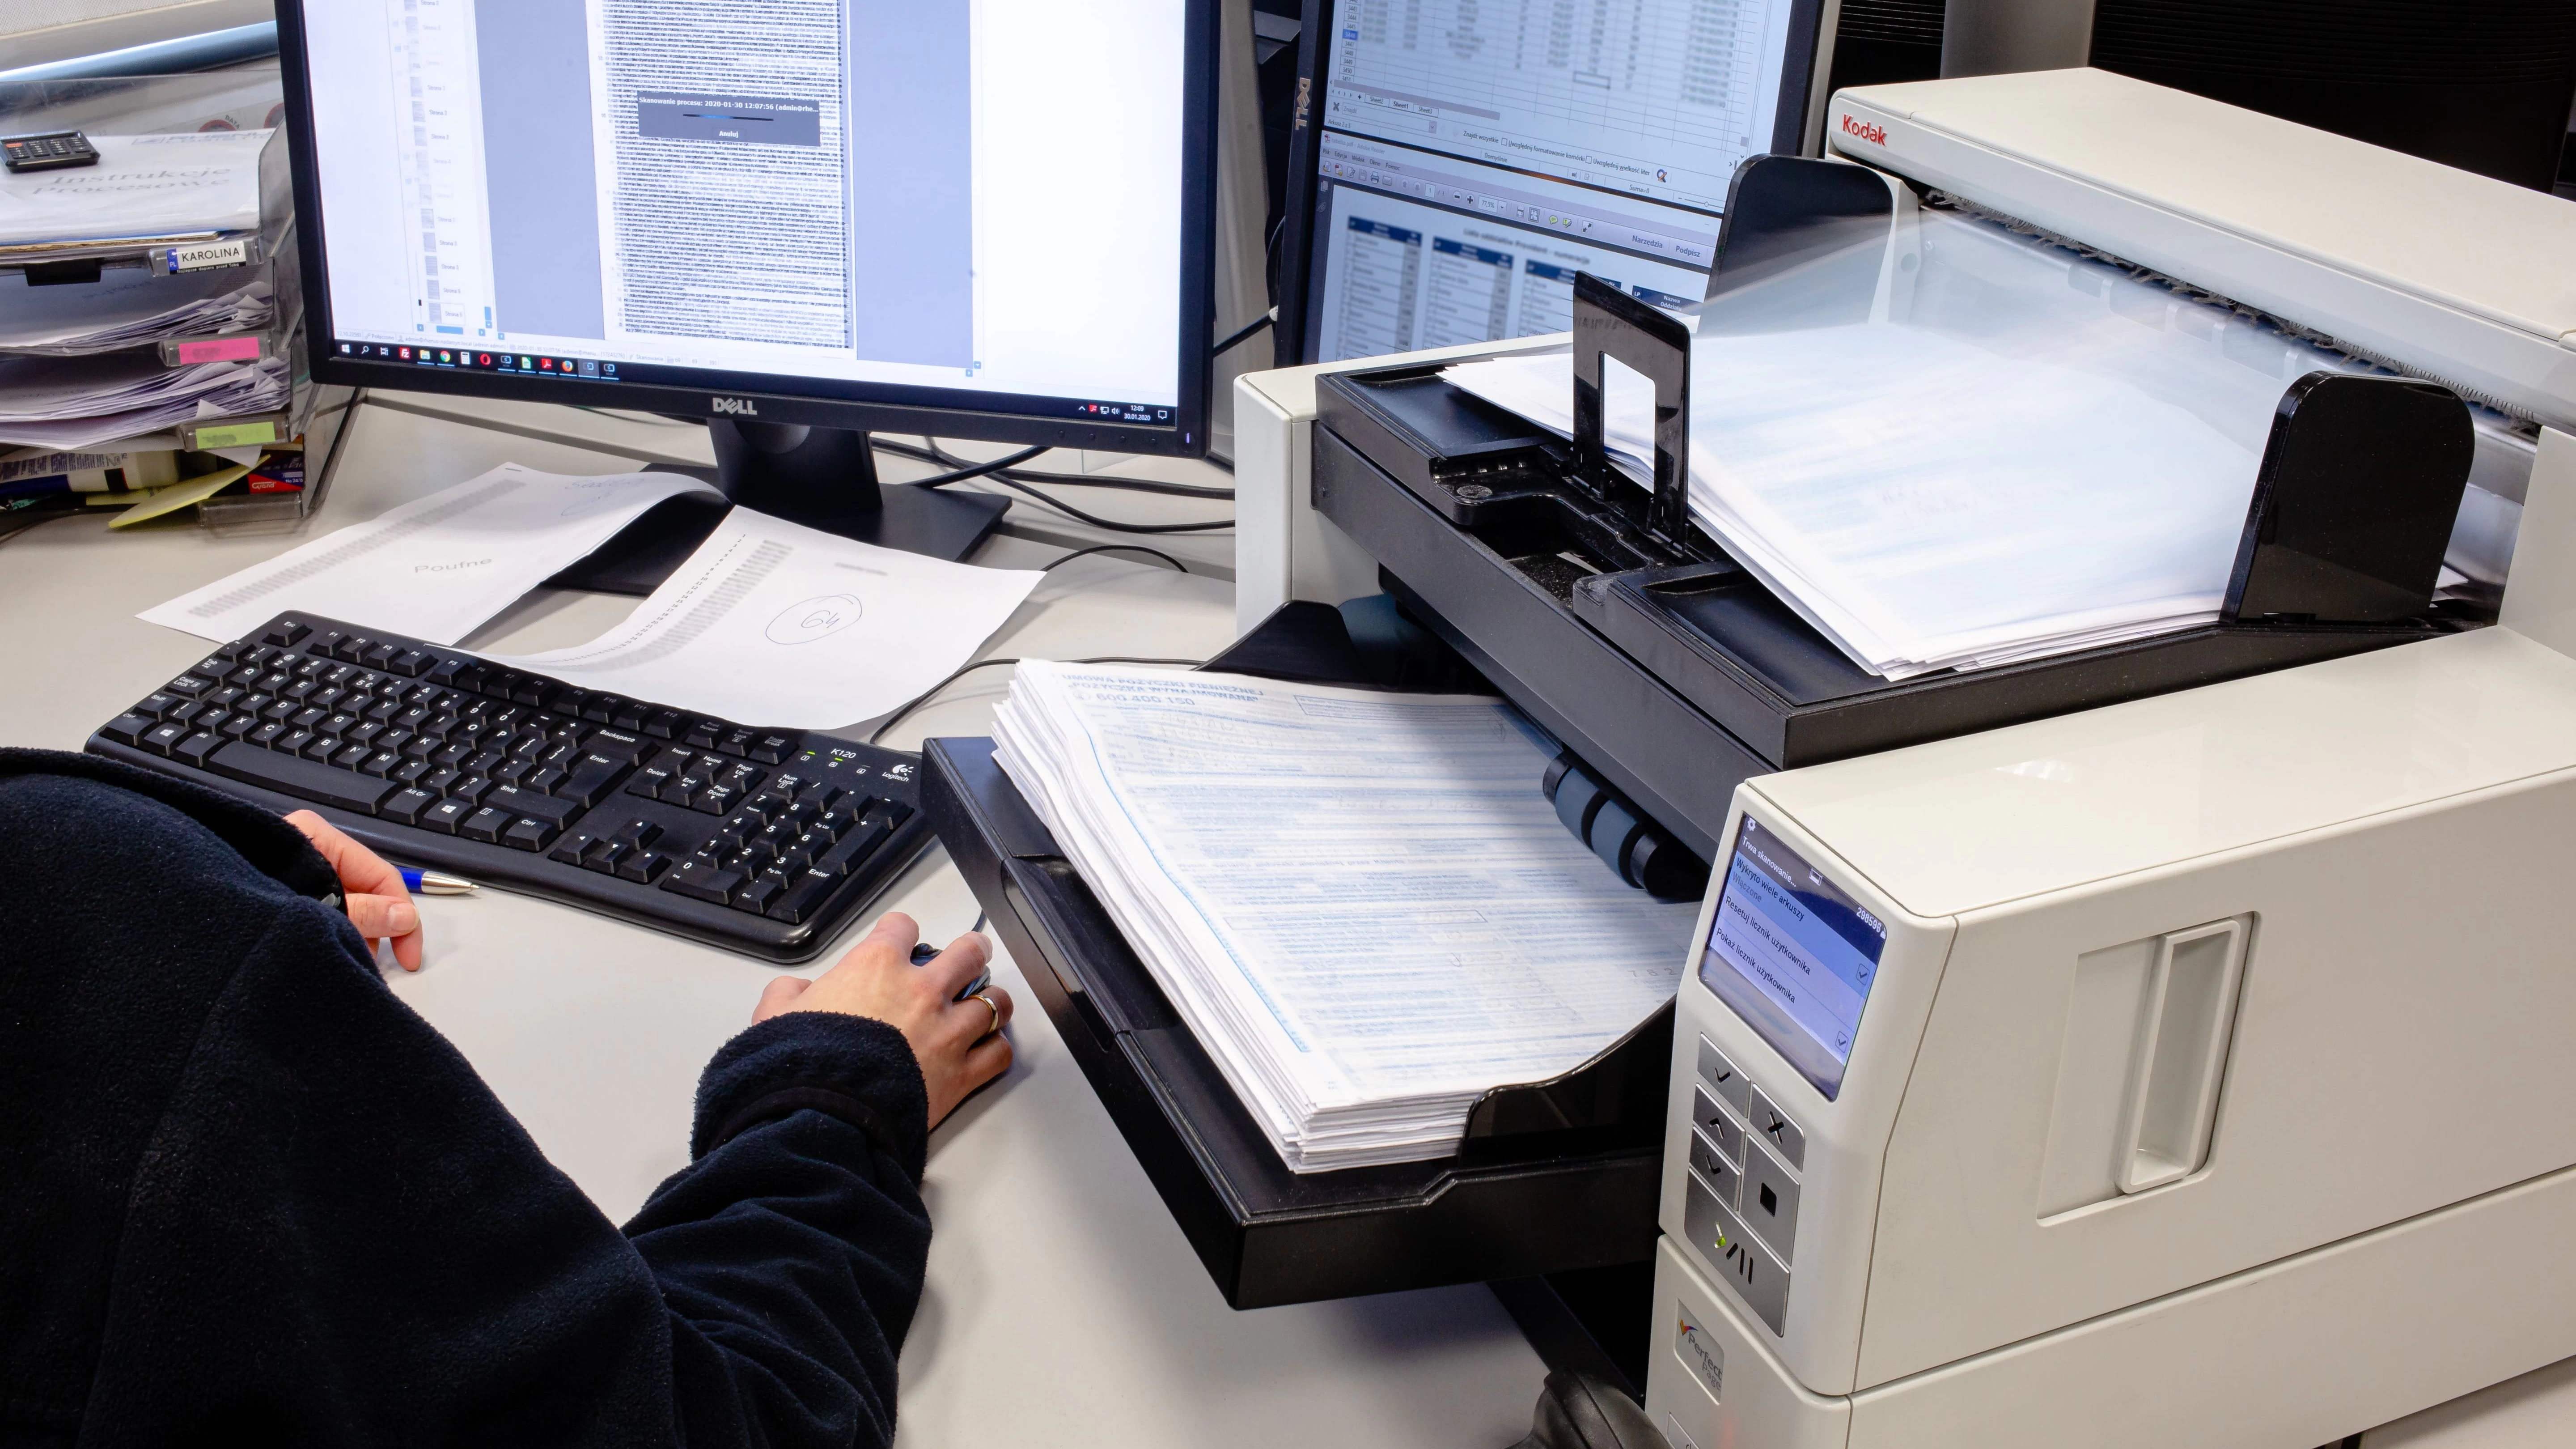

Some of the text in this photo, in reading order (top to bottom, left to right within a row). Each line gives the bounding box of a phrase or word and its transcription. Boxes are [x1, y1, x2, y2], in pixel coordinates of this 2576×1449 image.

[639, 98, 675, 106] Skanowanie
[677, 100, 703, 108] procesu:
[704, 100, 743, 108] 2020-01-30
[775, 104, 819, 113] (admin@rhe...
[1295, 77, 1311, 130] DELL
[1370, 96, 1384, 104] Sheet2
[1393, 101, 1409, 109] Sheet1
[1328, 119, 1341, 127] Arkusz
[719, 130, 738, 138] Anuluj
[1842, 113, 1888, 147] Kodak
[1463, 130, 1499, 144] Znajdź wszystkie
[1335, 151, 1347, 159] Edycja
[1508, 140, 1585, 161] Uwzględnij formatowanie komórki
[1484, 152, 1508, 163] Domyślnie
[1385, 163, 1400, 171] Pomoc
[1593, 158, 1619, 170] Uwzględnij
[1619, 164, 1640, 174] wielkość
[53, 168, 230, 184] Instrukcje
[33, 180, 229, 194] Procesowe
[1629, 184, 1650, 194] Suma=0
[1632, 235, 1663, 249] Narzędzia
[182, 247, 239, 262] KAROLINA
[1675, 245, 1700, 258] Podpisz
[1664, 295, 1680, 304] Nazwa
[712, 397, 757, 415] DELL
[415, 558, 492, 574] Poufne
[801, 609, 841, 629] 64
[174, 680, 188, 688] Lock
[1062, 674, 1114, 684] UMOWA
[1096, 693, 1127, 703] 600
[1132, 695, 1162, 704] 400
[599, 729, 636, 743] Backspace
[671, 748, 691, 756] Insert
[830, 748, 856, 759] K120
[589, 754, 610, 764] Enter
[703, 755, 722, 764] Home
[647, 768, 668, 777] Delete
[881, 772, 910, 782] Logitech
[500, 785, 517, 794] Shift
[708, 789, 726, 797] Down
[713, 784, 730, 793] Page
[1742, 836, 1797, 888] Trwa skanowanie...
[808, 868, 830, 878] Enter
[1733, 871, 1762, 903] Włączone
[1737, 857, 1805, 921] Wykryto wiele arkuszy
[1856, 906, 1881, 934] 298596
[1725, 895, 1811, 976] Resetuj licznik użytkownika
[1716, 927, 1796, 1003] Pokaż licznik użytkownika
[1688, 1331, 1722, 1381] Perfect
